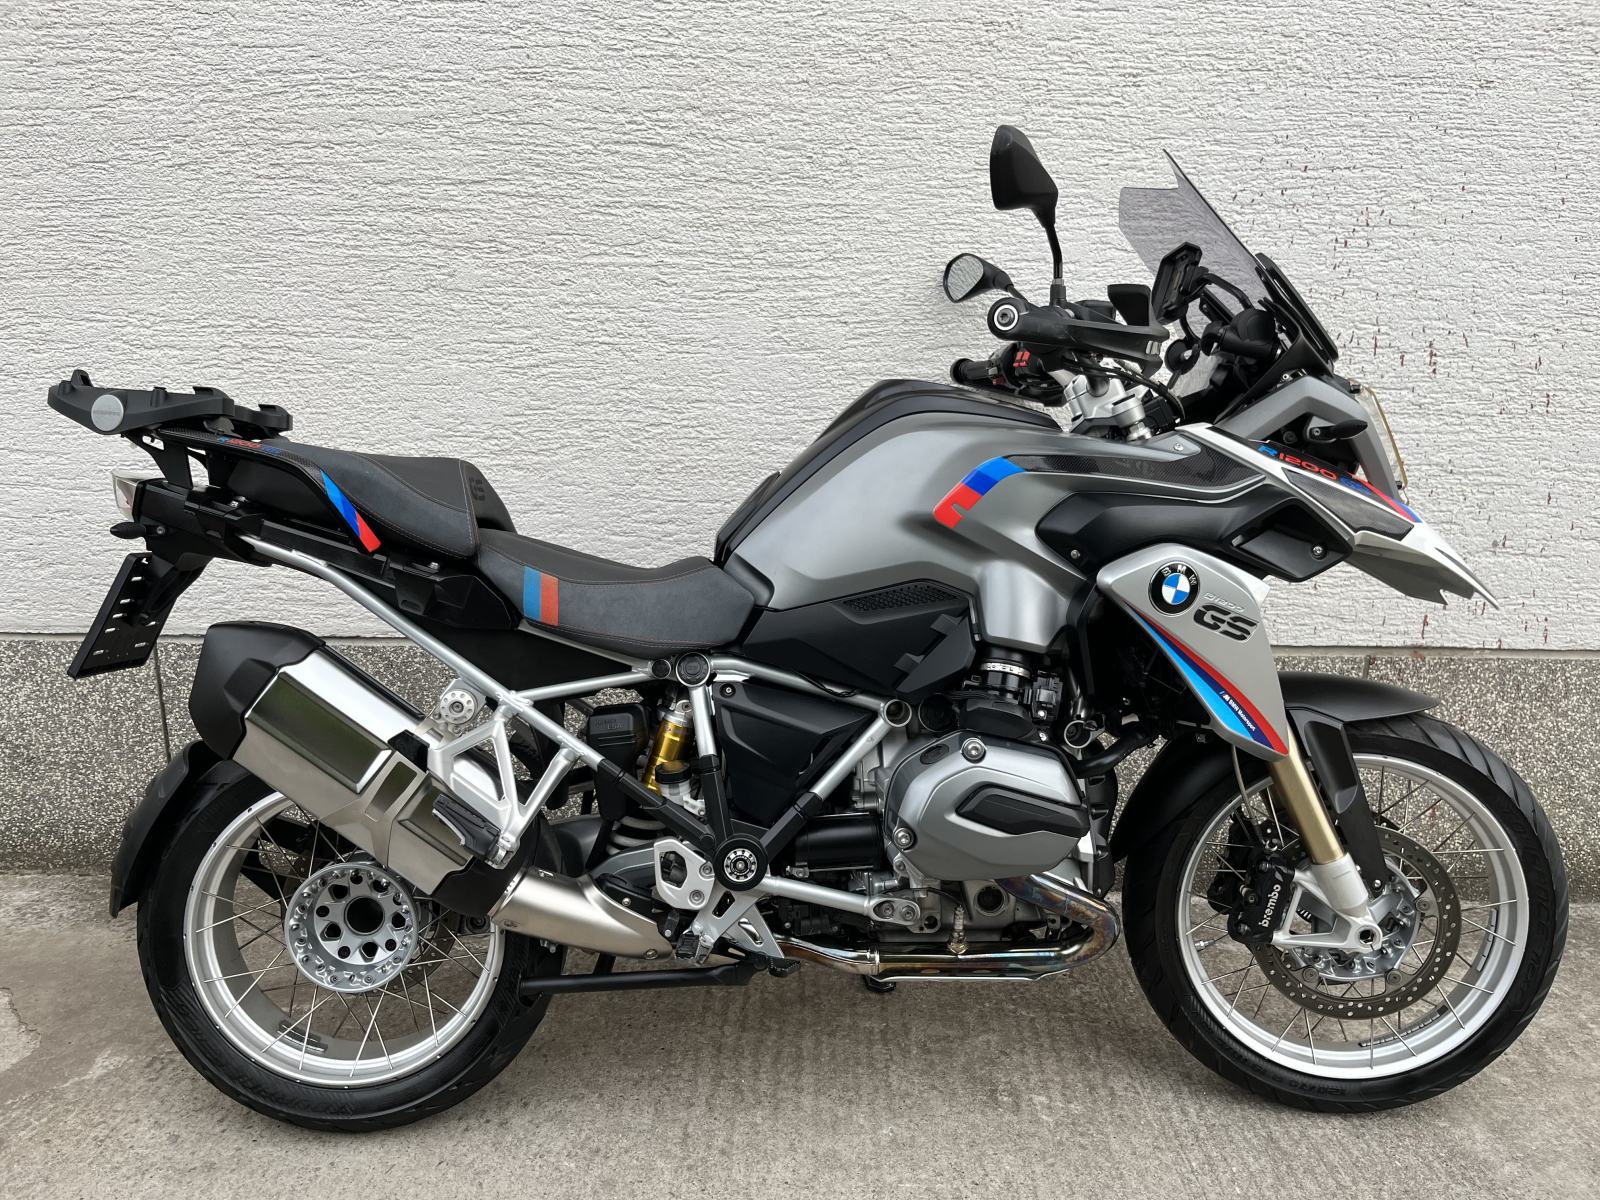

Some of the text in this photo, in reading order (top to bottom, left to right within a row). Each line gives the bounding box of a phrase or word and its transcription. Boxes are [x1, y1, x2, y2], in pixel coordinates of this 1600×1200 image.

[1160, 563, 1198, 586] BMW
[1193, 603, 1257, 642] GS
[1228, 699, 1240, 712] BMW
[1258, 883, 1282, 928] brembo
